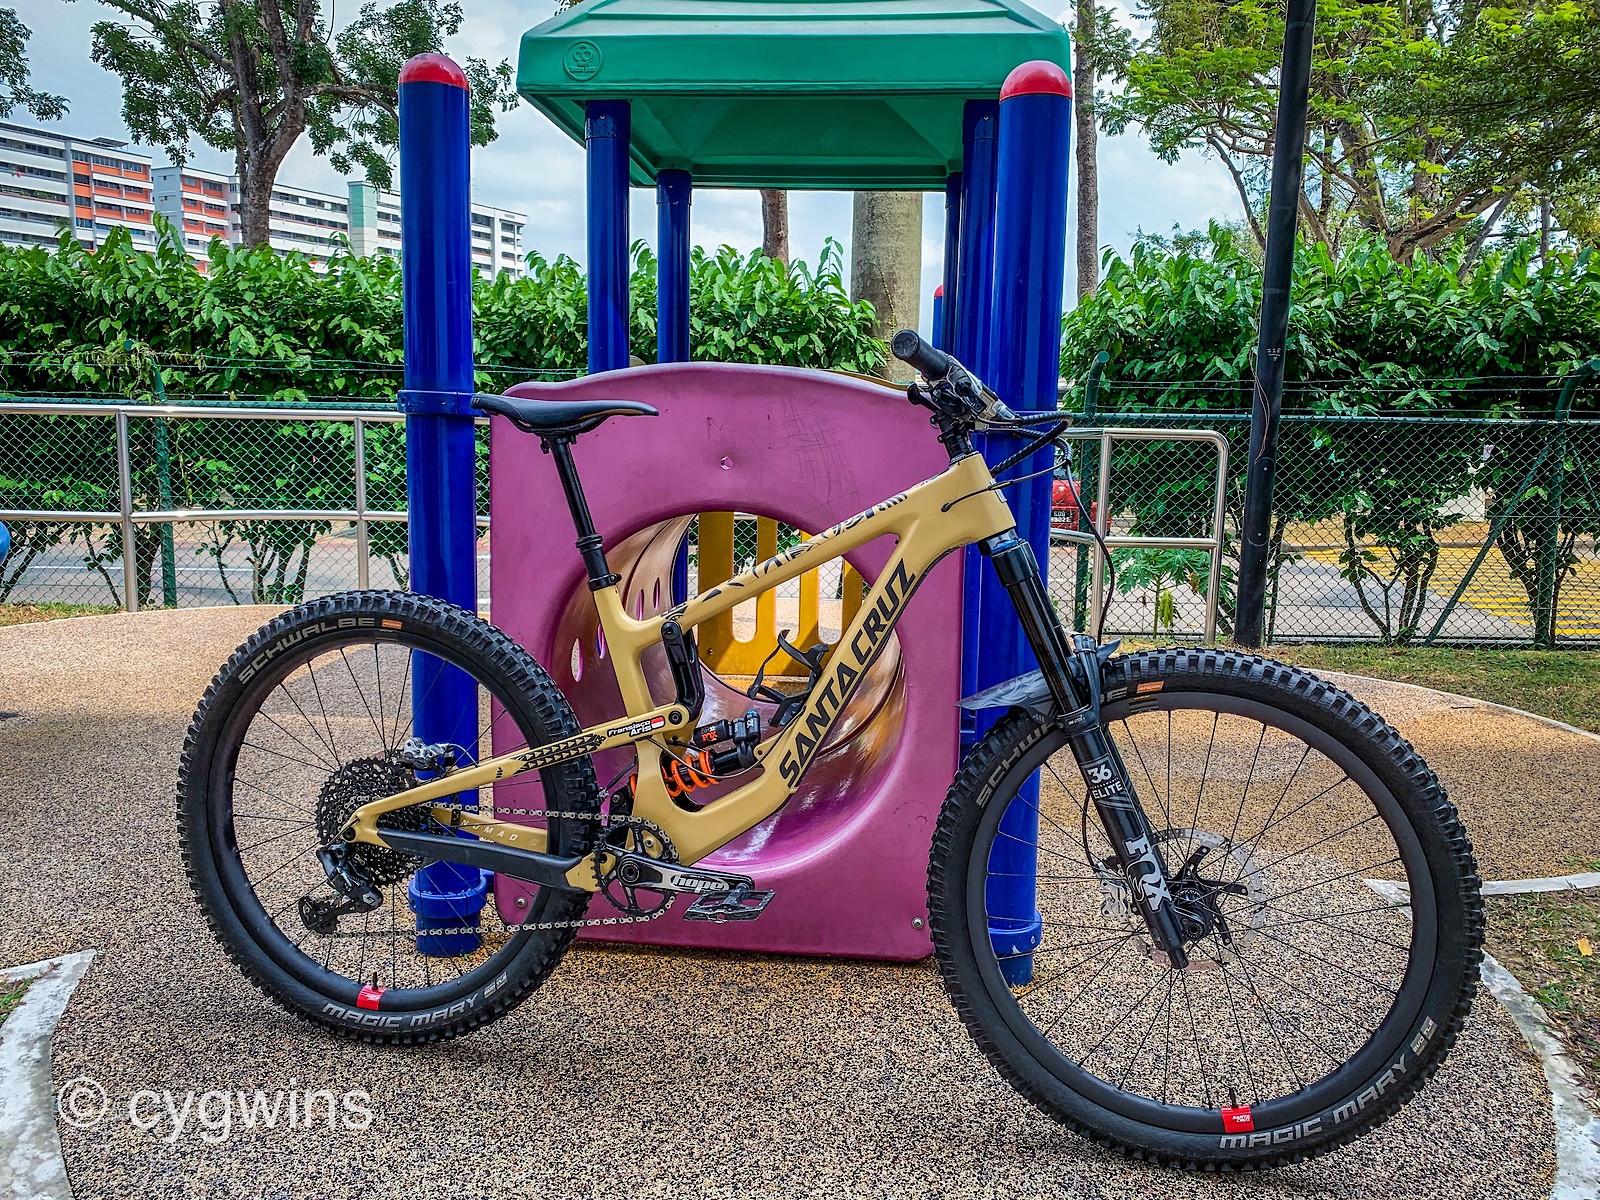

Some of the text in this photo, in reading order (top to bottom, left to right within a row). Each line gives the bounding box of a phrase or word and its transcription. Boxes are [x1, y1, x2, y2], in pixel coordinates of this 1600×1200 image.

[237, 617, 375, 685] SCHWALBE
[779, 557, 917, 788] SANTA CRUZ
[607, 719, 651, 737] Fransisco
[630, 724, 652, 736] Aris
[701, 730, 718, 742] FOX
[1087, 763, 1113, 784] 36
[1091, 780, 1124, 800] ELITE
[460, 819, 519, 841] NOMAD
[1124, 832, 1173, 911] FOX
[672, 874, 725, 894] hope
[321, 993, 479, 1028] MAGIC MARY
[1219, 1117, 1322, 1149] MAGIC
[1332, 1053, 1408, 1124] MARY
